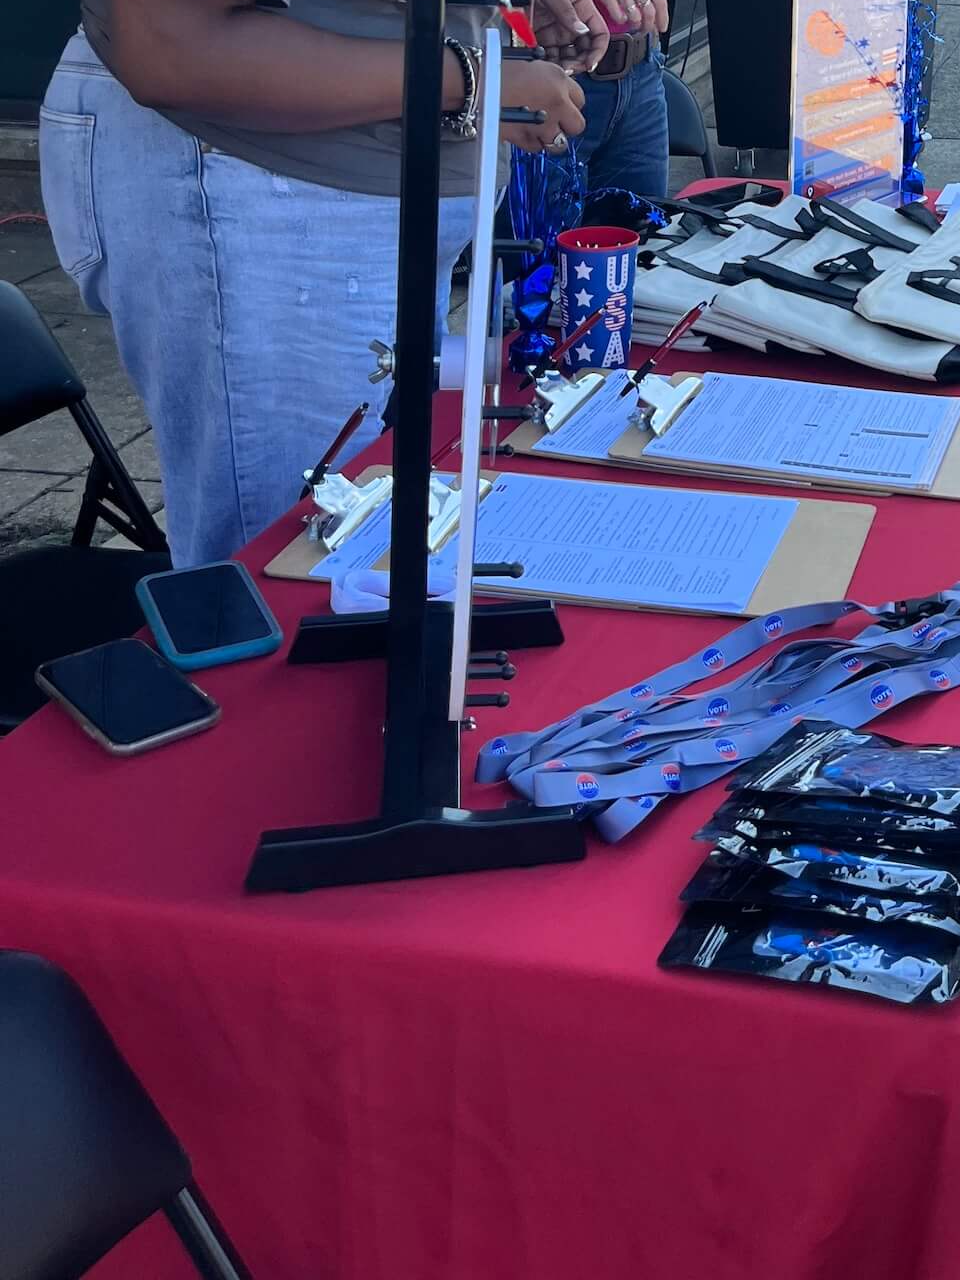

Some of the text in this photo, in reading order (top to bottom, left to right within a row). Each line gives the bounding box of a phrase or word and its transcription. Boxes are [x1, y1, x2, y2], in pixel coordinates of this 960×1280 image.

[602, 253, 629, 368] USA
[764, 620, 783, 634] VOTE
[703, 651, 723, 668] VOTE
[871, 689, 895, 705] VOTE
[708, 703, 728, 716] VOTE
[715, 741, 736, 752] VOTE
[577, 782, 599, 793] VOTE
